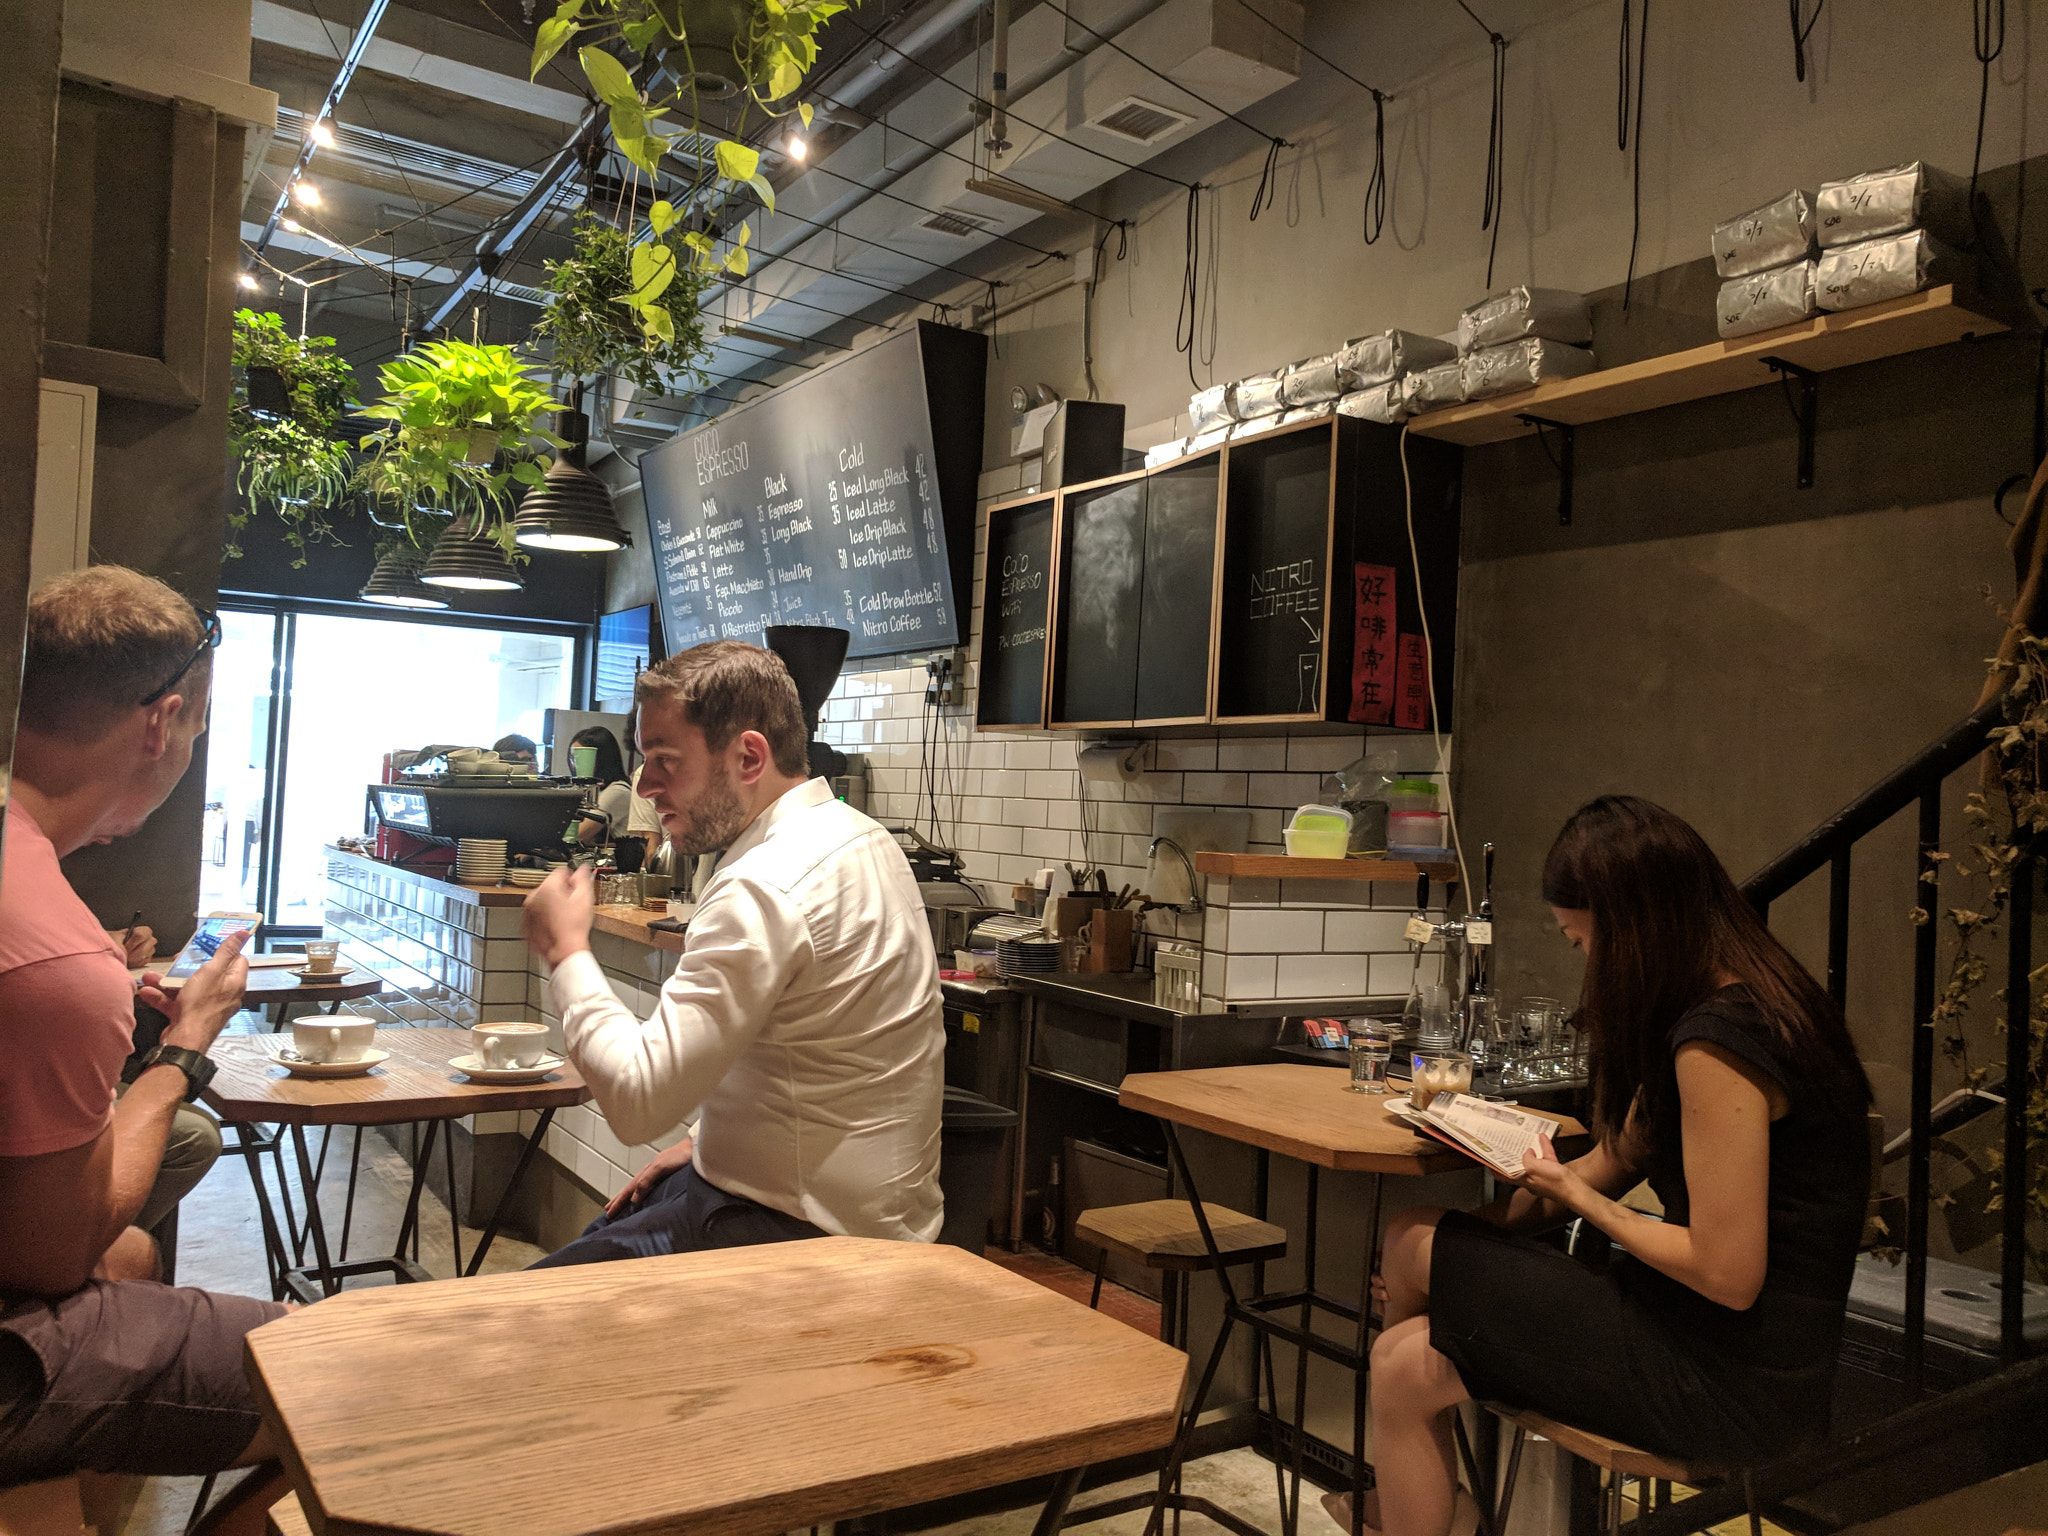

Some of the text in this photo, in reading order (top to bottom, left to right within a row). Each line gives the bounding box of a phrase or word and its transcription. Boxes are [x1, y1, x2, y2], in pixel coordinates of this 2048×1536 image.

[694, 427, 720, 461] COCO
[839, 442, 864, 472] Cold
[697, 441, 749, 486] ESPRESSO
[843, 453, 927, 498] Iced Long Black 42
[764, 473, 788, 499] Black
[768, 480, 838, 520] Espresso 25
[846, 479, 930, 521] Iced Latte 42
[702, 497, 718, 519] Milk
[771, 504, 841, 544] Long Black 35
[706, 518, 744, 541] Cappuccino
[849, 507, 935, 545] Ice Drip Black 48
[709, 544, 724, 559] Flat
[724, 538, 745, 555] White
[853, 531, 939, 568] Ice Drip Latte 48
[712, 564, 734, 579] Latte
[778, 548, 848, 583] Hand Drip 50
[1251, 559, 1313, 596] NITRO
[730, 578, 764, 598] Macchiato
[859, 592, 881, 613] Cold
[881, 590, 905, 610] Brew
[904, 587, 934, 607] Bottle
[1250, 587, 1320, 620] COFFEE
[718, 600, 743, 618] Piccolo
[862, 619, 888, 637] Nitro
[889, 613, 922, 633] Coffee
[1359, 575, 1388, 710] 好啡常在
